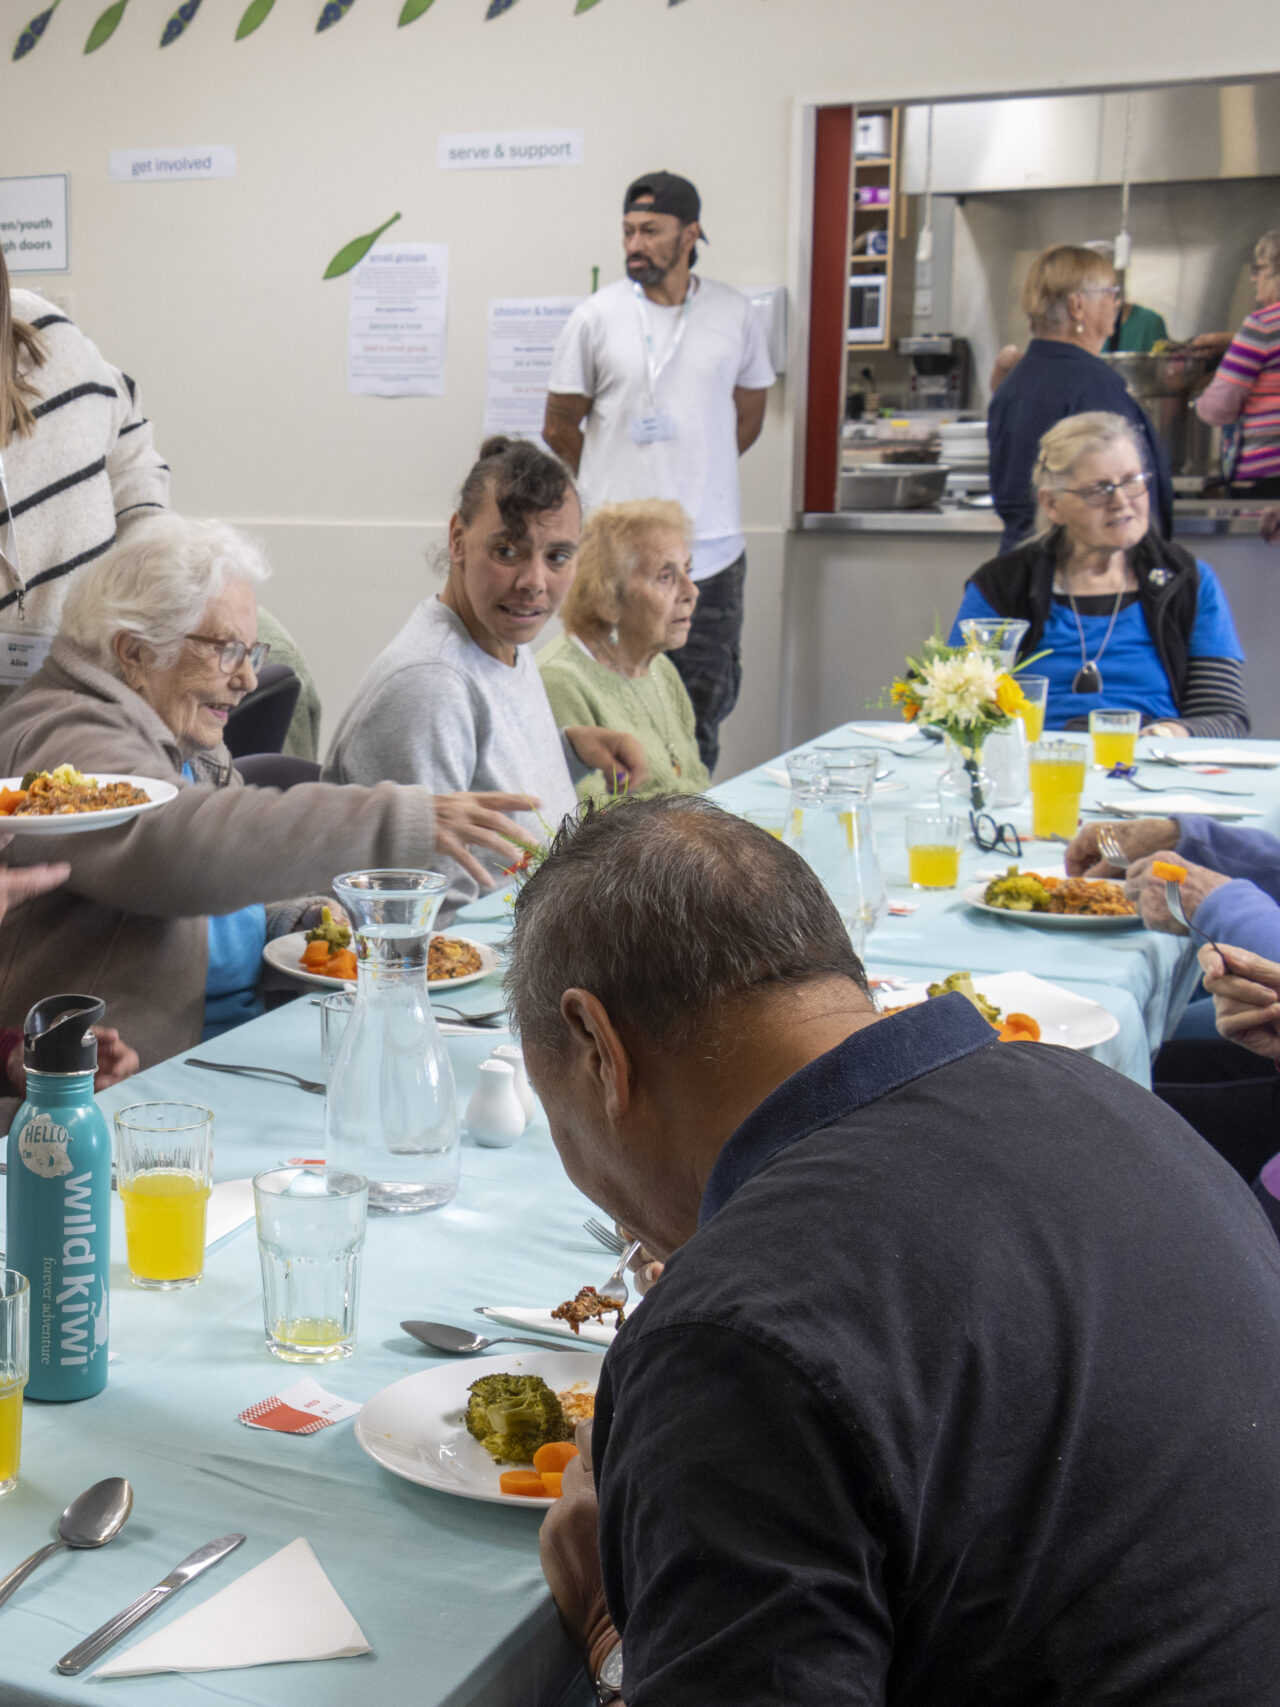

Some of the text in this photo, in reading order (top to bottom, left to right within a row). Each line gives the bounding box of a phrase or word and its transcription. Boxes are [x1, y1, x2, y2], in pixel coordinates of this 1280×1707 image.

[448, 142, 572, 160] serve & support
[131, 154, 212, 176] get involved
[19, 239, 52, 250] doors
[62, 1171, 97, 1266] wild
[41, 1256, 57, 1365] forever adventure
[303, 1399, 320, 1409] RED
